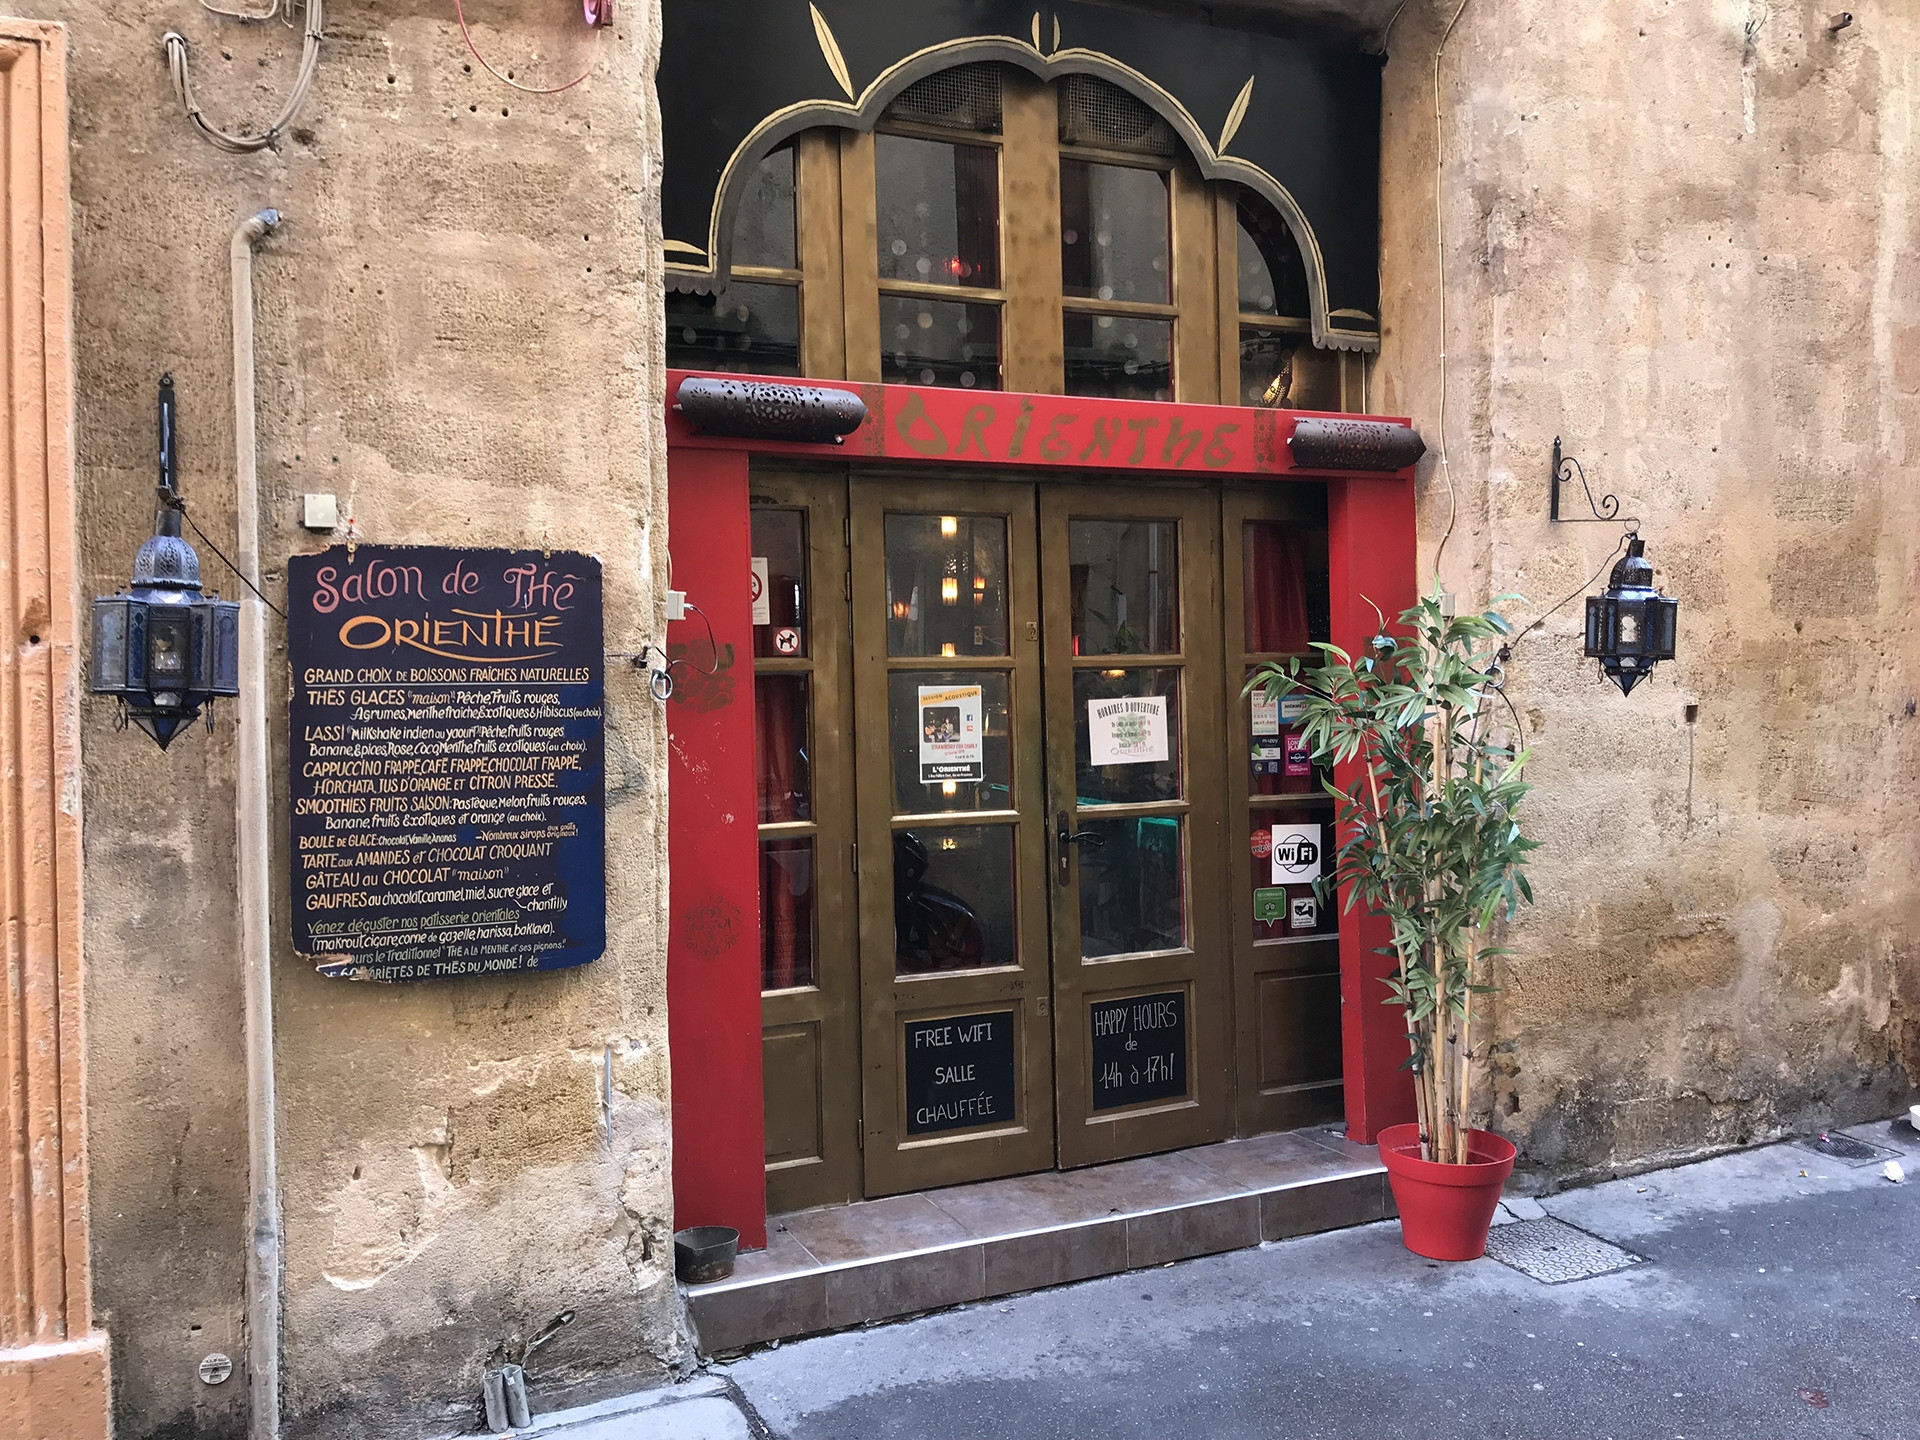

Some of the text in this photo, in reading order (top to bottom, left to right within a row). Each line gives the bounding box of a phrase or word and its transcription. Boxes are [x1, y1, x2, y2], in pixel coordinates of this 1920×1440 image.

[312, 559, 430, 614] Salon
[442, 558, 486, 596] de
[304, 668, 354, 684] GRAND
[357, 667, 392, 683] CHOIX
[396, 671, 408, 682] DE
[410, 667, 467, 682] BOISSONS
[520, 667, 589, 681] NATURELLES
[945, 690, 978, 701] ACOUSTIQUE
[1096, 702, 1124, 719] HORAIRES
[304, 724, 345, 741] LASSI
[403, 726, 434, 740] indien
[434, 730, 445, 740] ou
[302, 759, 382, 778] CAPPUCCINO
[488, 756, 540, 773] CHOCOLAT
[377, 778, 399, 794] JUS
[400, 776, 452, 792] D'ORANGE
[454, 779, 466, 791] ET
[469, 774, 511, 790] CITRON
[295, 797, 366, 815] SMOOTHIES
[369, 796, 408, 812] FRUITS
[458, 813, 470, 825] et
[299, 835, 335, 849] BOULE
[337, 838, 346, 847] DE
[520, 829, 546, 840] sirops
[301, 842, 554, 869] TARTE aux AMANDES et CHOCOLAT CROQUANT
[305, 871, 360, 890] GÂTEAU
[362, 875, 378, 887] au
[383, 867, 450, 886] CHOCOLAT
[305, 891, 367, 911] GAUFRES
[367, 894, 381, 907] au
[542, 882, 554, 895] et
[526, 895, 568, 912] chantilly
[307, 919, 345, 934] Venez
[347, 917, 399, 934] déguster
[401, 917, 418, 929] nos
[428, 932, 438, 943] de
[375, 950, 385, 963] le
[480, 944, 509, 955] MENTHE
[416, 965, 430, 976] DE
[468, 962, 481, 972] DU
[527, 955, 539, 968] de
[1094, 1000, 1178, 1037] HAPPY HOURS
[915, 1022, 993, 1049] FREE WIFI
[1125, 1033, 1138, 1051] de
[934, 1064, 976, 1085] SALLE
[1098, 1052, 1175, 1090] 14h à 17h!
[916, 1091, 996, 1125] CHAUFFÉE
